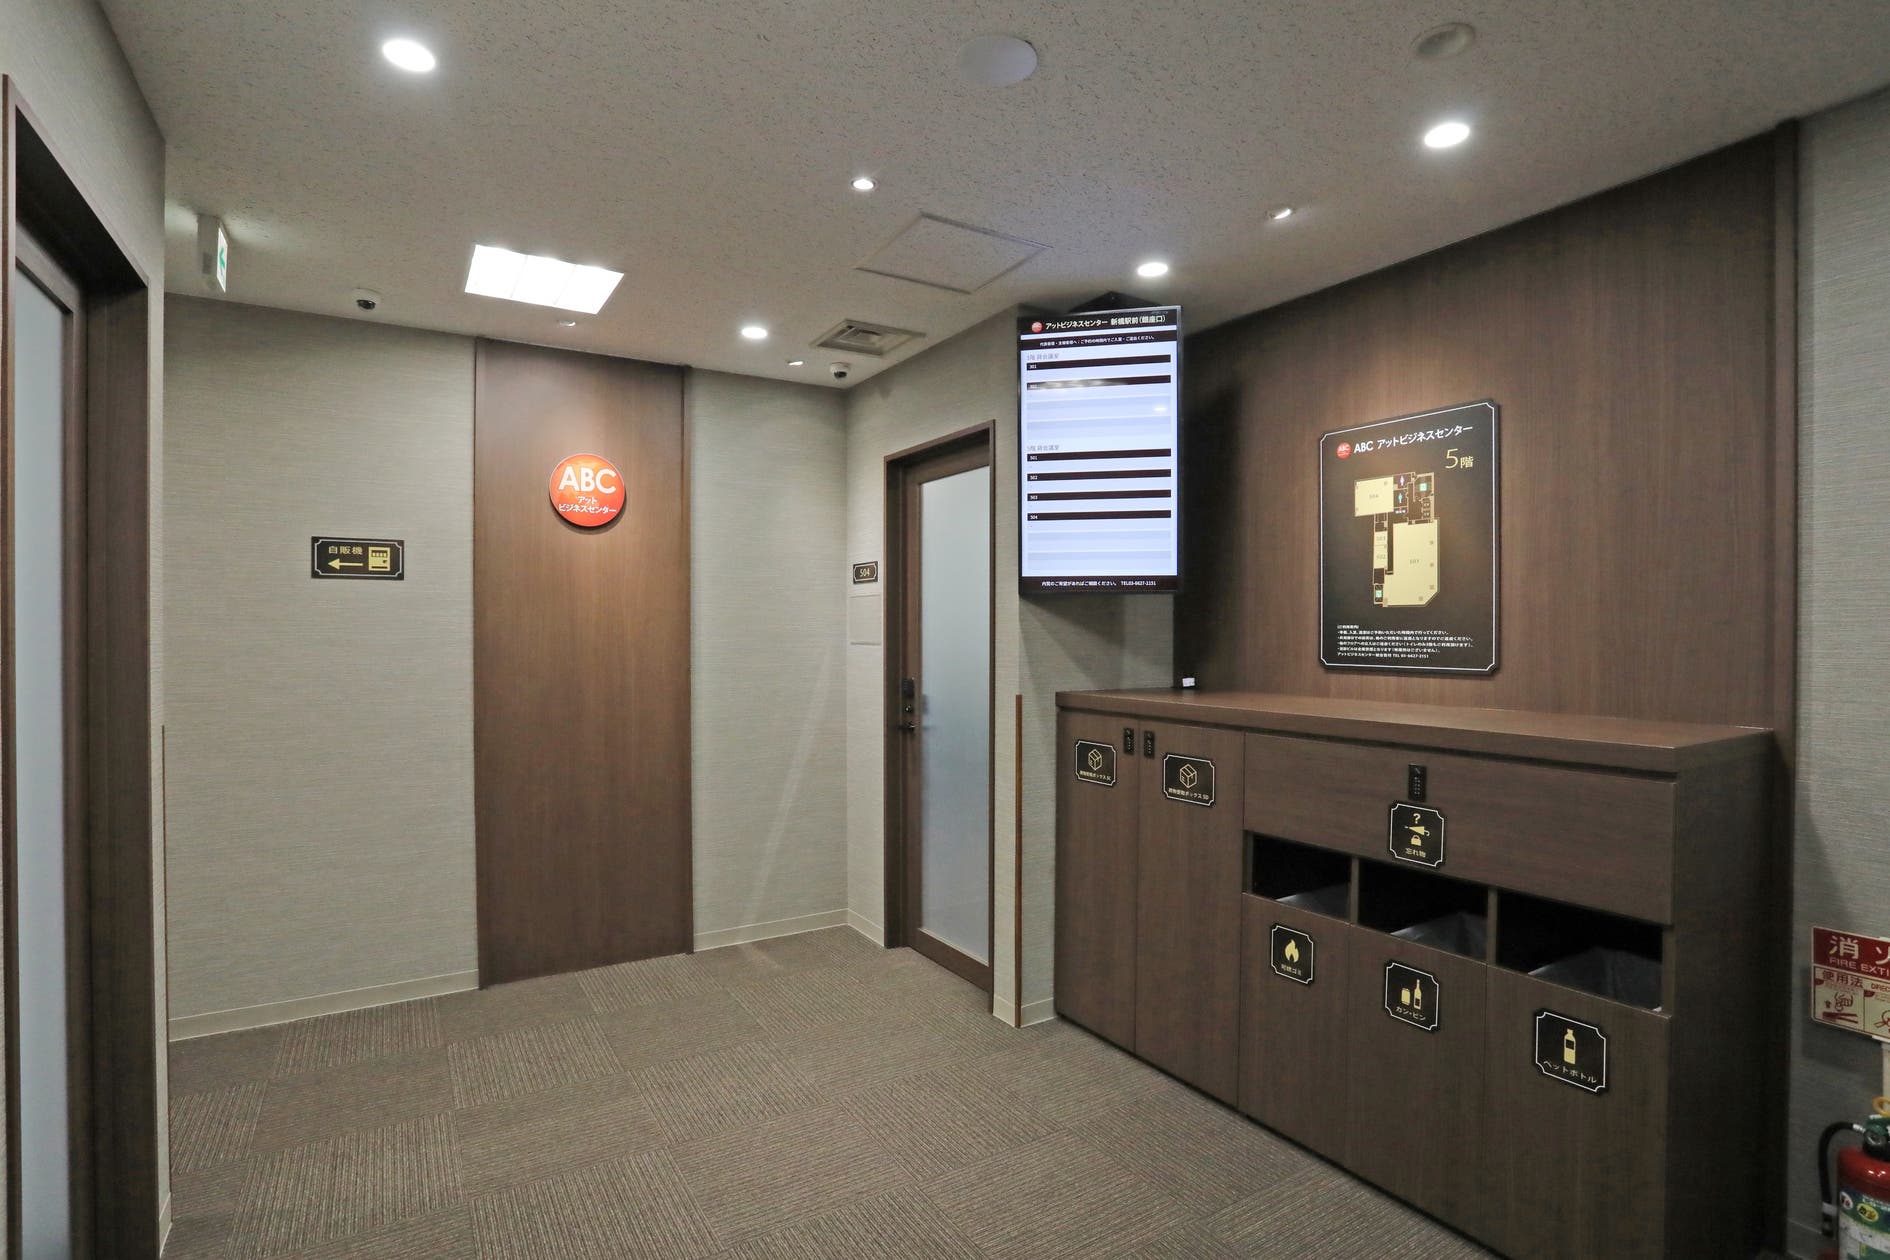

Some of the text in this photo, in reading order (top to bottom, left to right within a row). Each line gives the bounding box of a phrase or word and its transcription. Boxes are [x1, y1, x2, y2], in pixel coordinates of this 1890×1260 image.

[1046, 319, 1109, 329] アットビジネスセンター
[1354, 425, 1473, 453] ABC アットビジネスセンター
[1445, 448, 1474, 469] 5階
[559, 466, 617, 494] ABC
[577, 496, 598, 505] アット
[558, 503, 617, 515] ビジネスセンター
[328, 545, 363, 555] 自販機
[860, 567, 870, 578] 504
[1405, 847, 1426, 858] 忘れ物
[1829, 957, 1857, 970] FIRE
